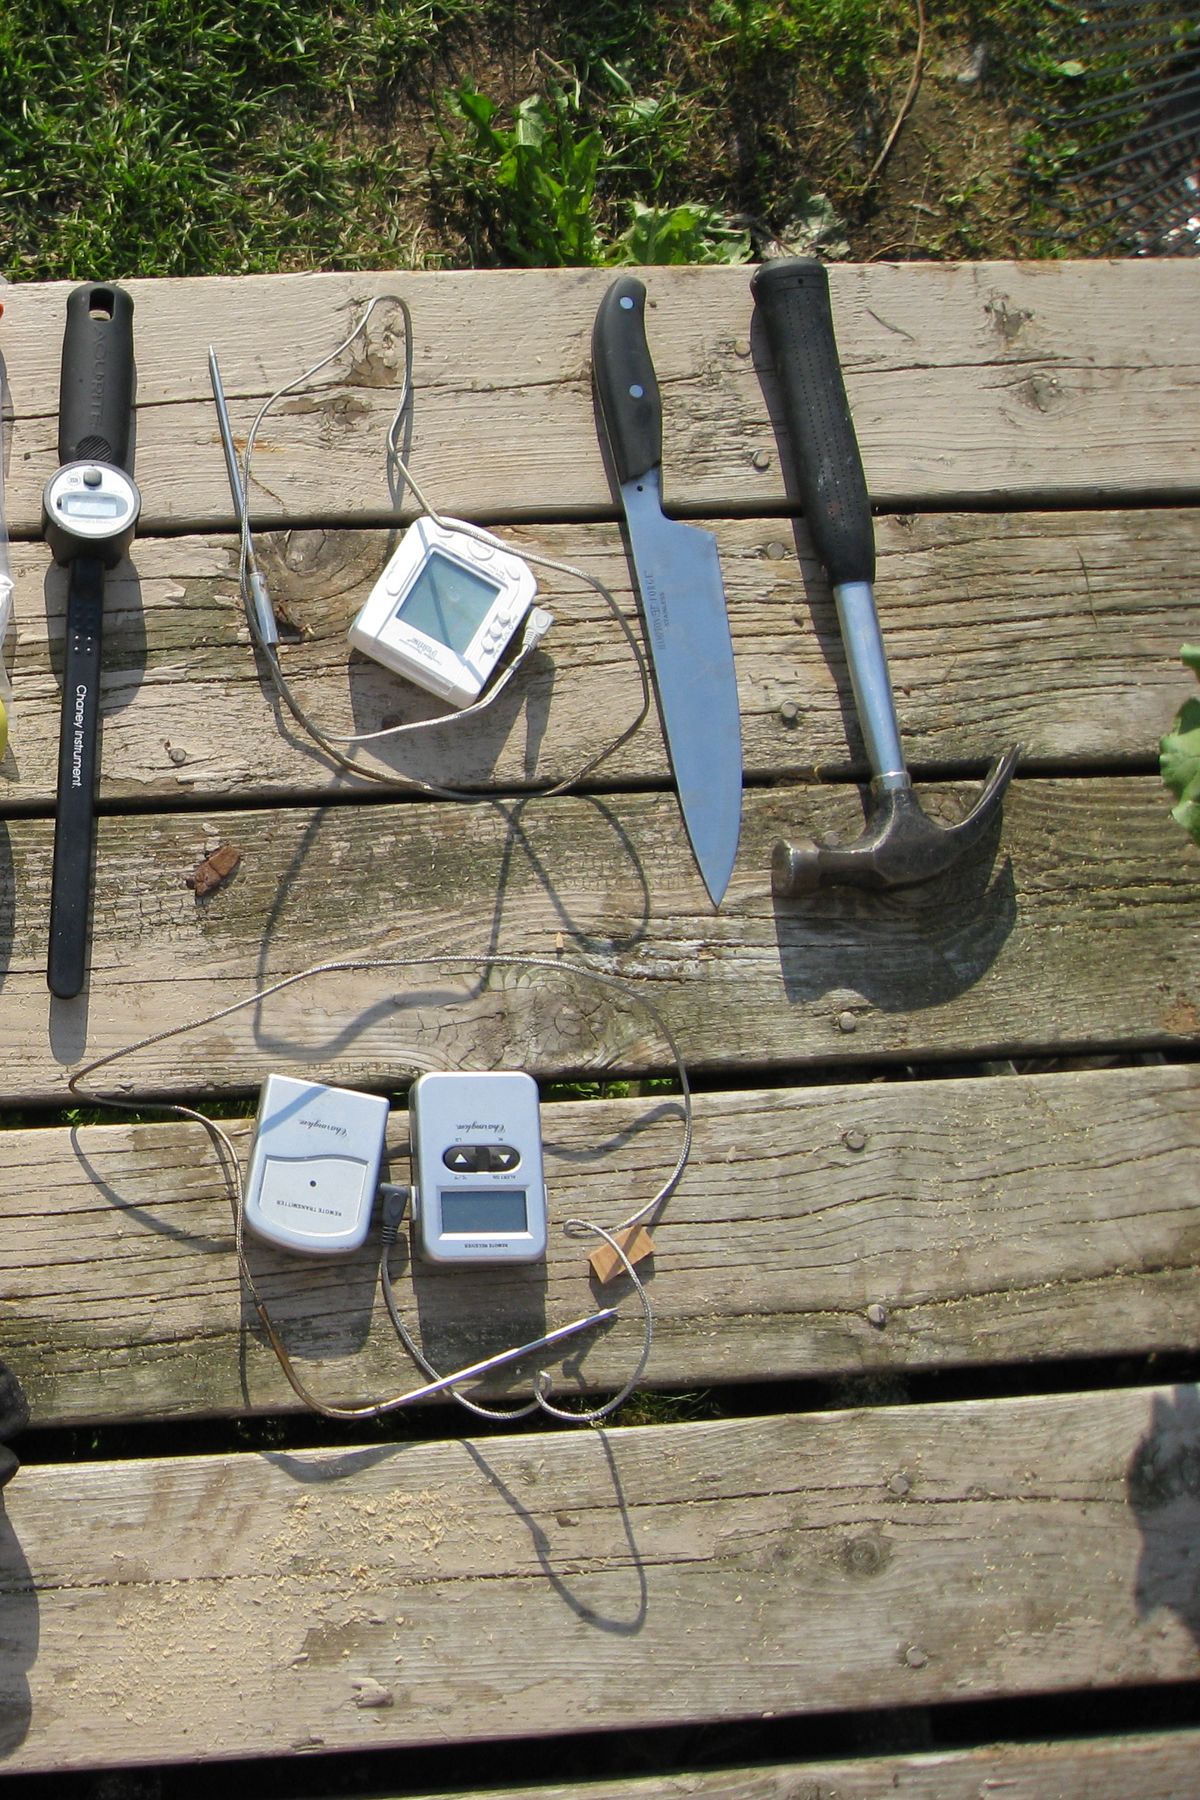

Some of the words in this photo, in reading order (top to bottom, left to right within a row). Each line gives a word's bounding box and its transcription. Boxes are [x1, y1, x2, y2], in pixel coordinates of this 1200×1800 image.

[73, 685, 87, 728] Chaney
[276, 1200, 317, 1213] TRANSMITTER
[317, 1207, 342, 1217] REMOTE
